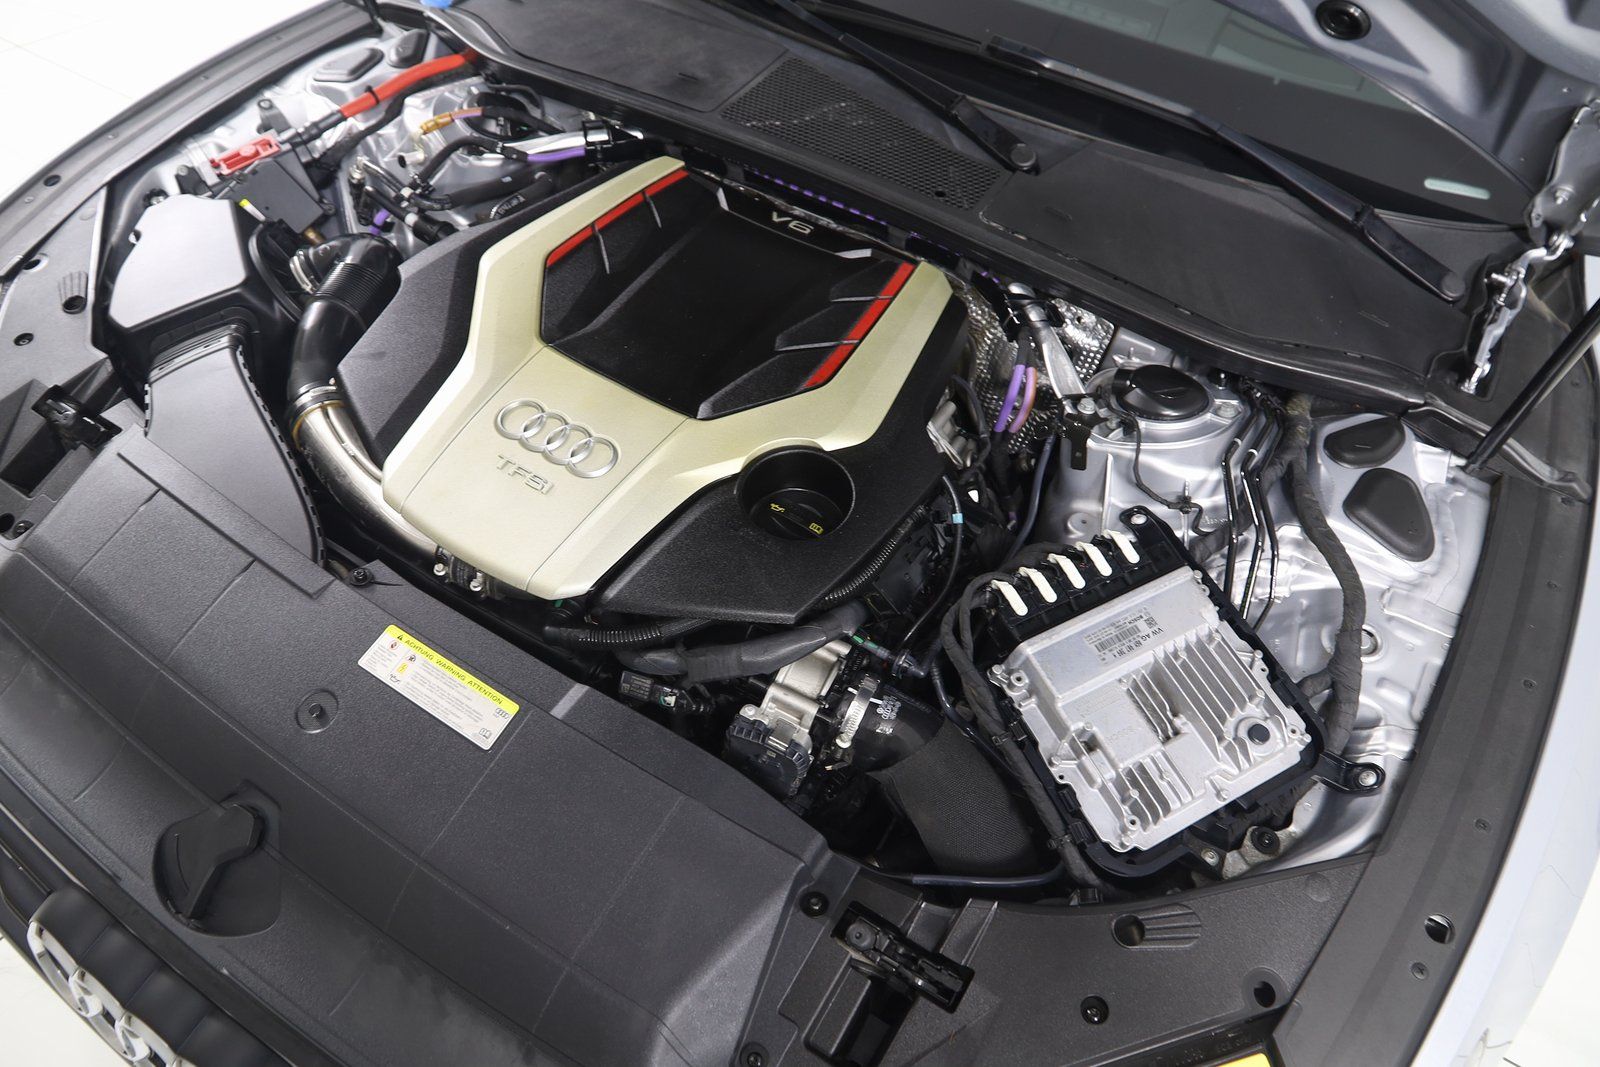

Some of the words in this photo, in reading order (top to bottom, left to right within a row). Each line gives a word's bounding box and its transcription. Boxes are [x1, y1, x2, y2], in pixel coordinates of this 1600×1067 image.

[772, 211, 814, 234] V6
[496, 454, 555, 495] TFSI
[1140, 634, 1151, 642] AG
[1151, 627, 1164, 637] VW
[404, 639, 434, 661] ACHTUNG
[435, 659, 467, 682] WARNING
[467, 680, 504, 706] ATTENTION
